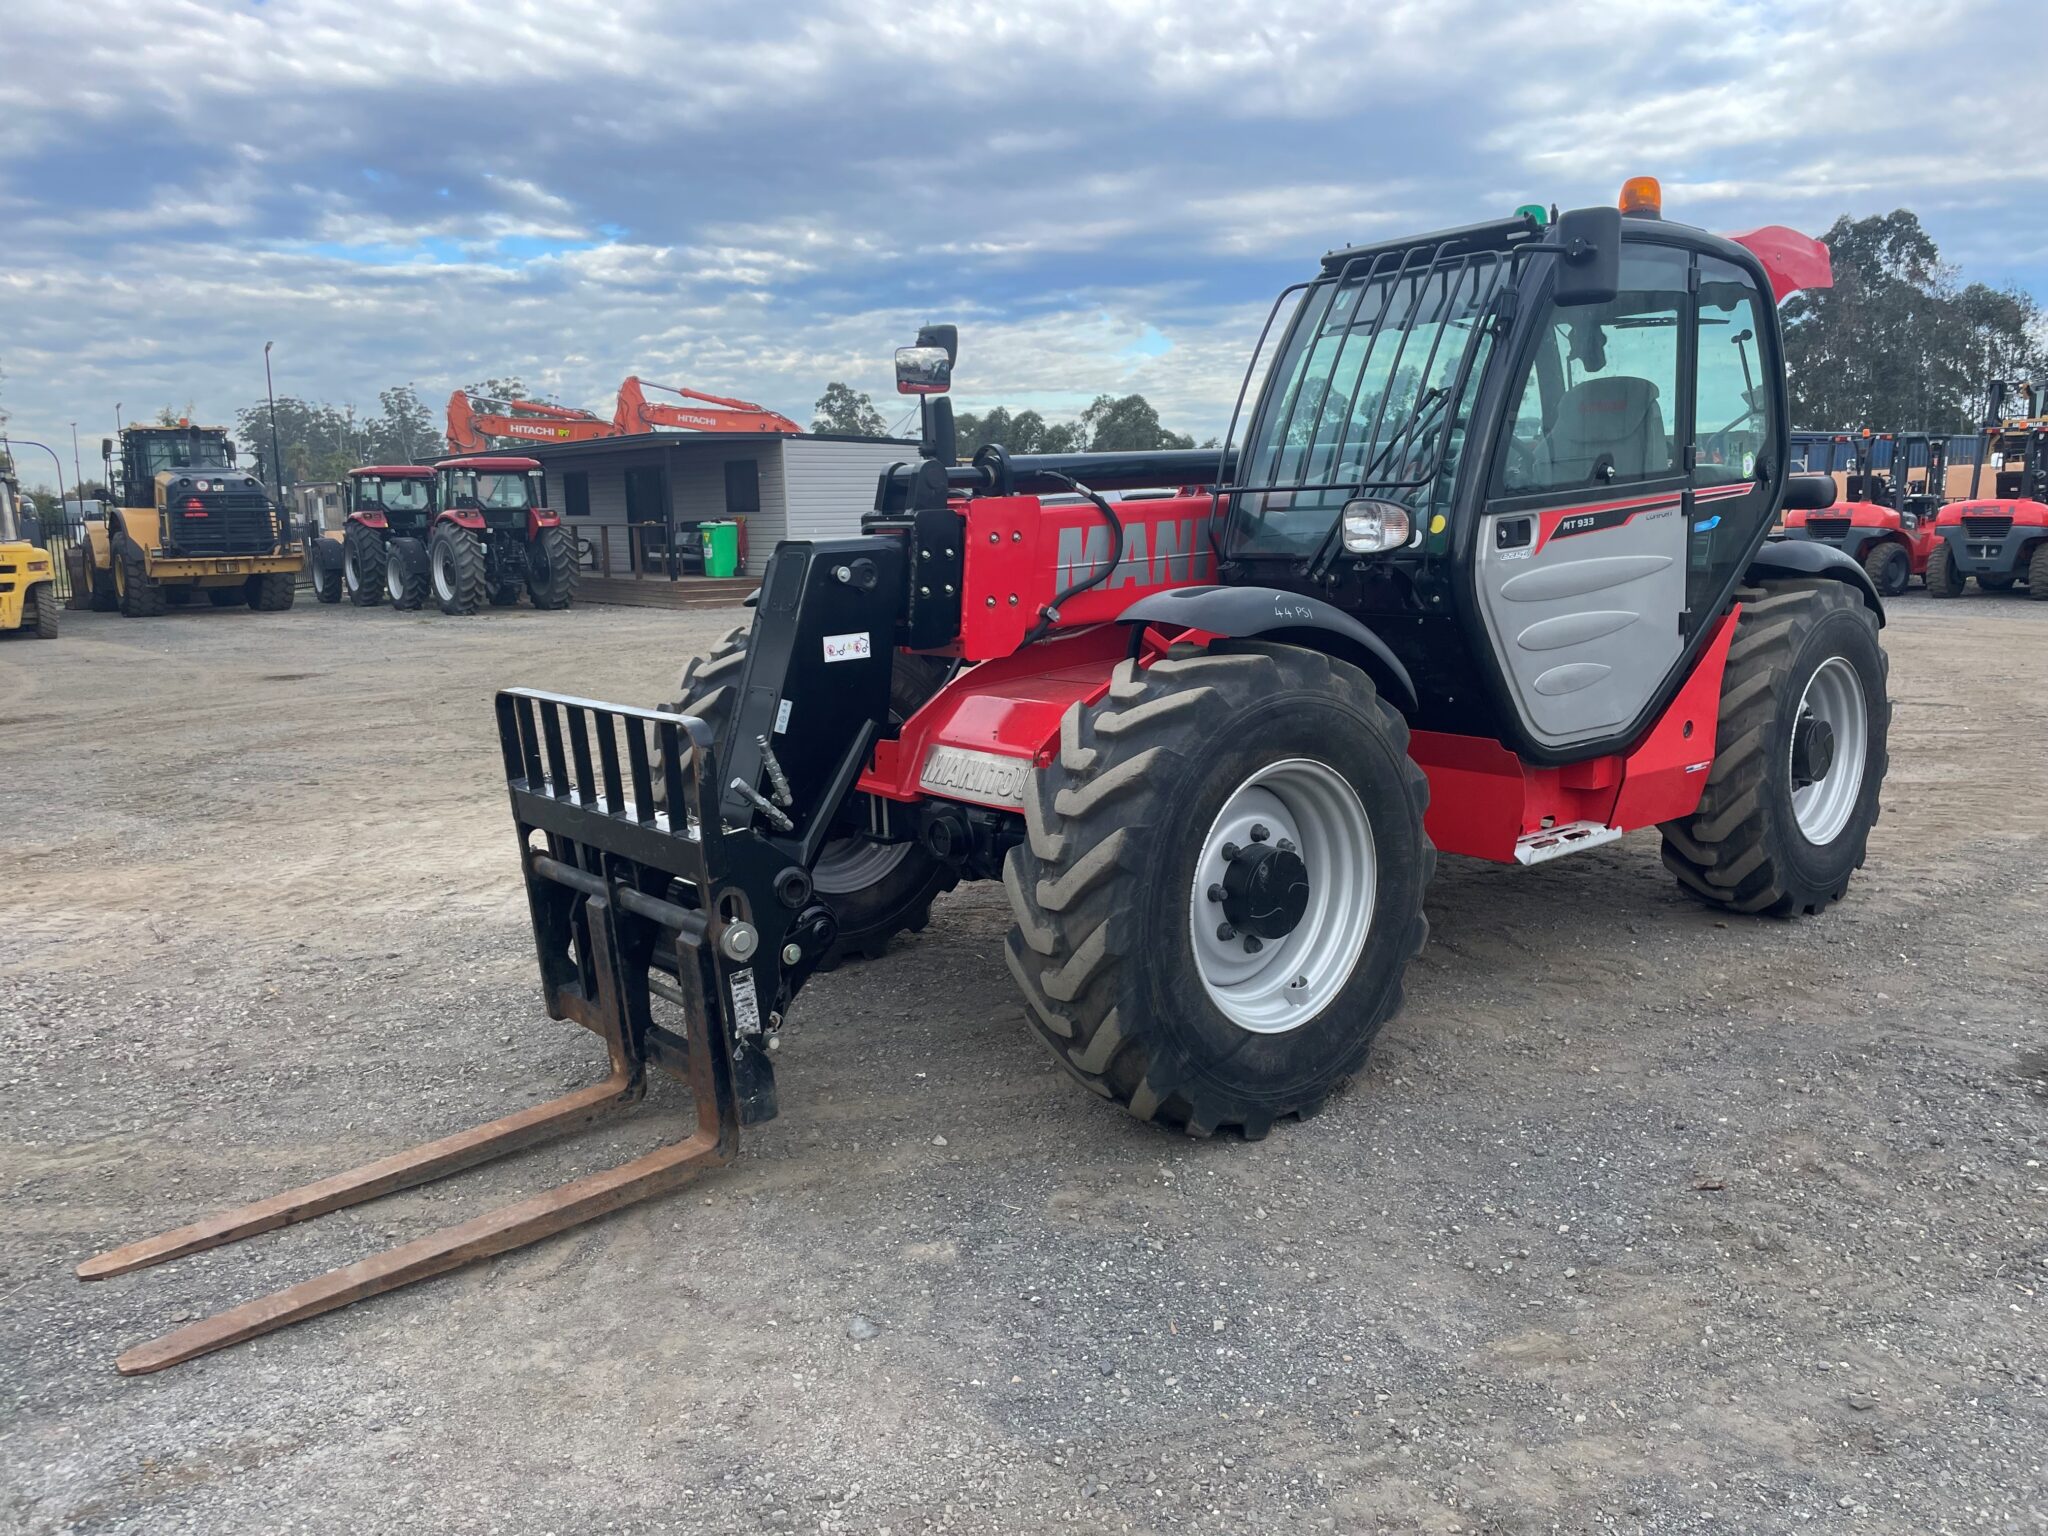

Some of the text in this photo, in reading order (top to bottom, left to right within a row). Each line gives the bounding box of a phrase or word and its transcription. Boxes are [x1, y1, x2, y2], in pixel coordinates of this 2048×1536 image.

[677, 414, 716, 426] HITACHI
[510, 424, 555, 437] HITACHI
[1562, 517, 1595, 530] MT 933
[1055, 515, 1225, 596] MANI
[1274, 606, 1313, 620] 44 PSI
